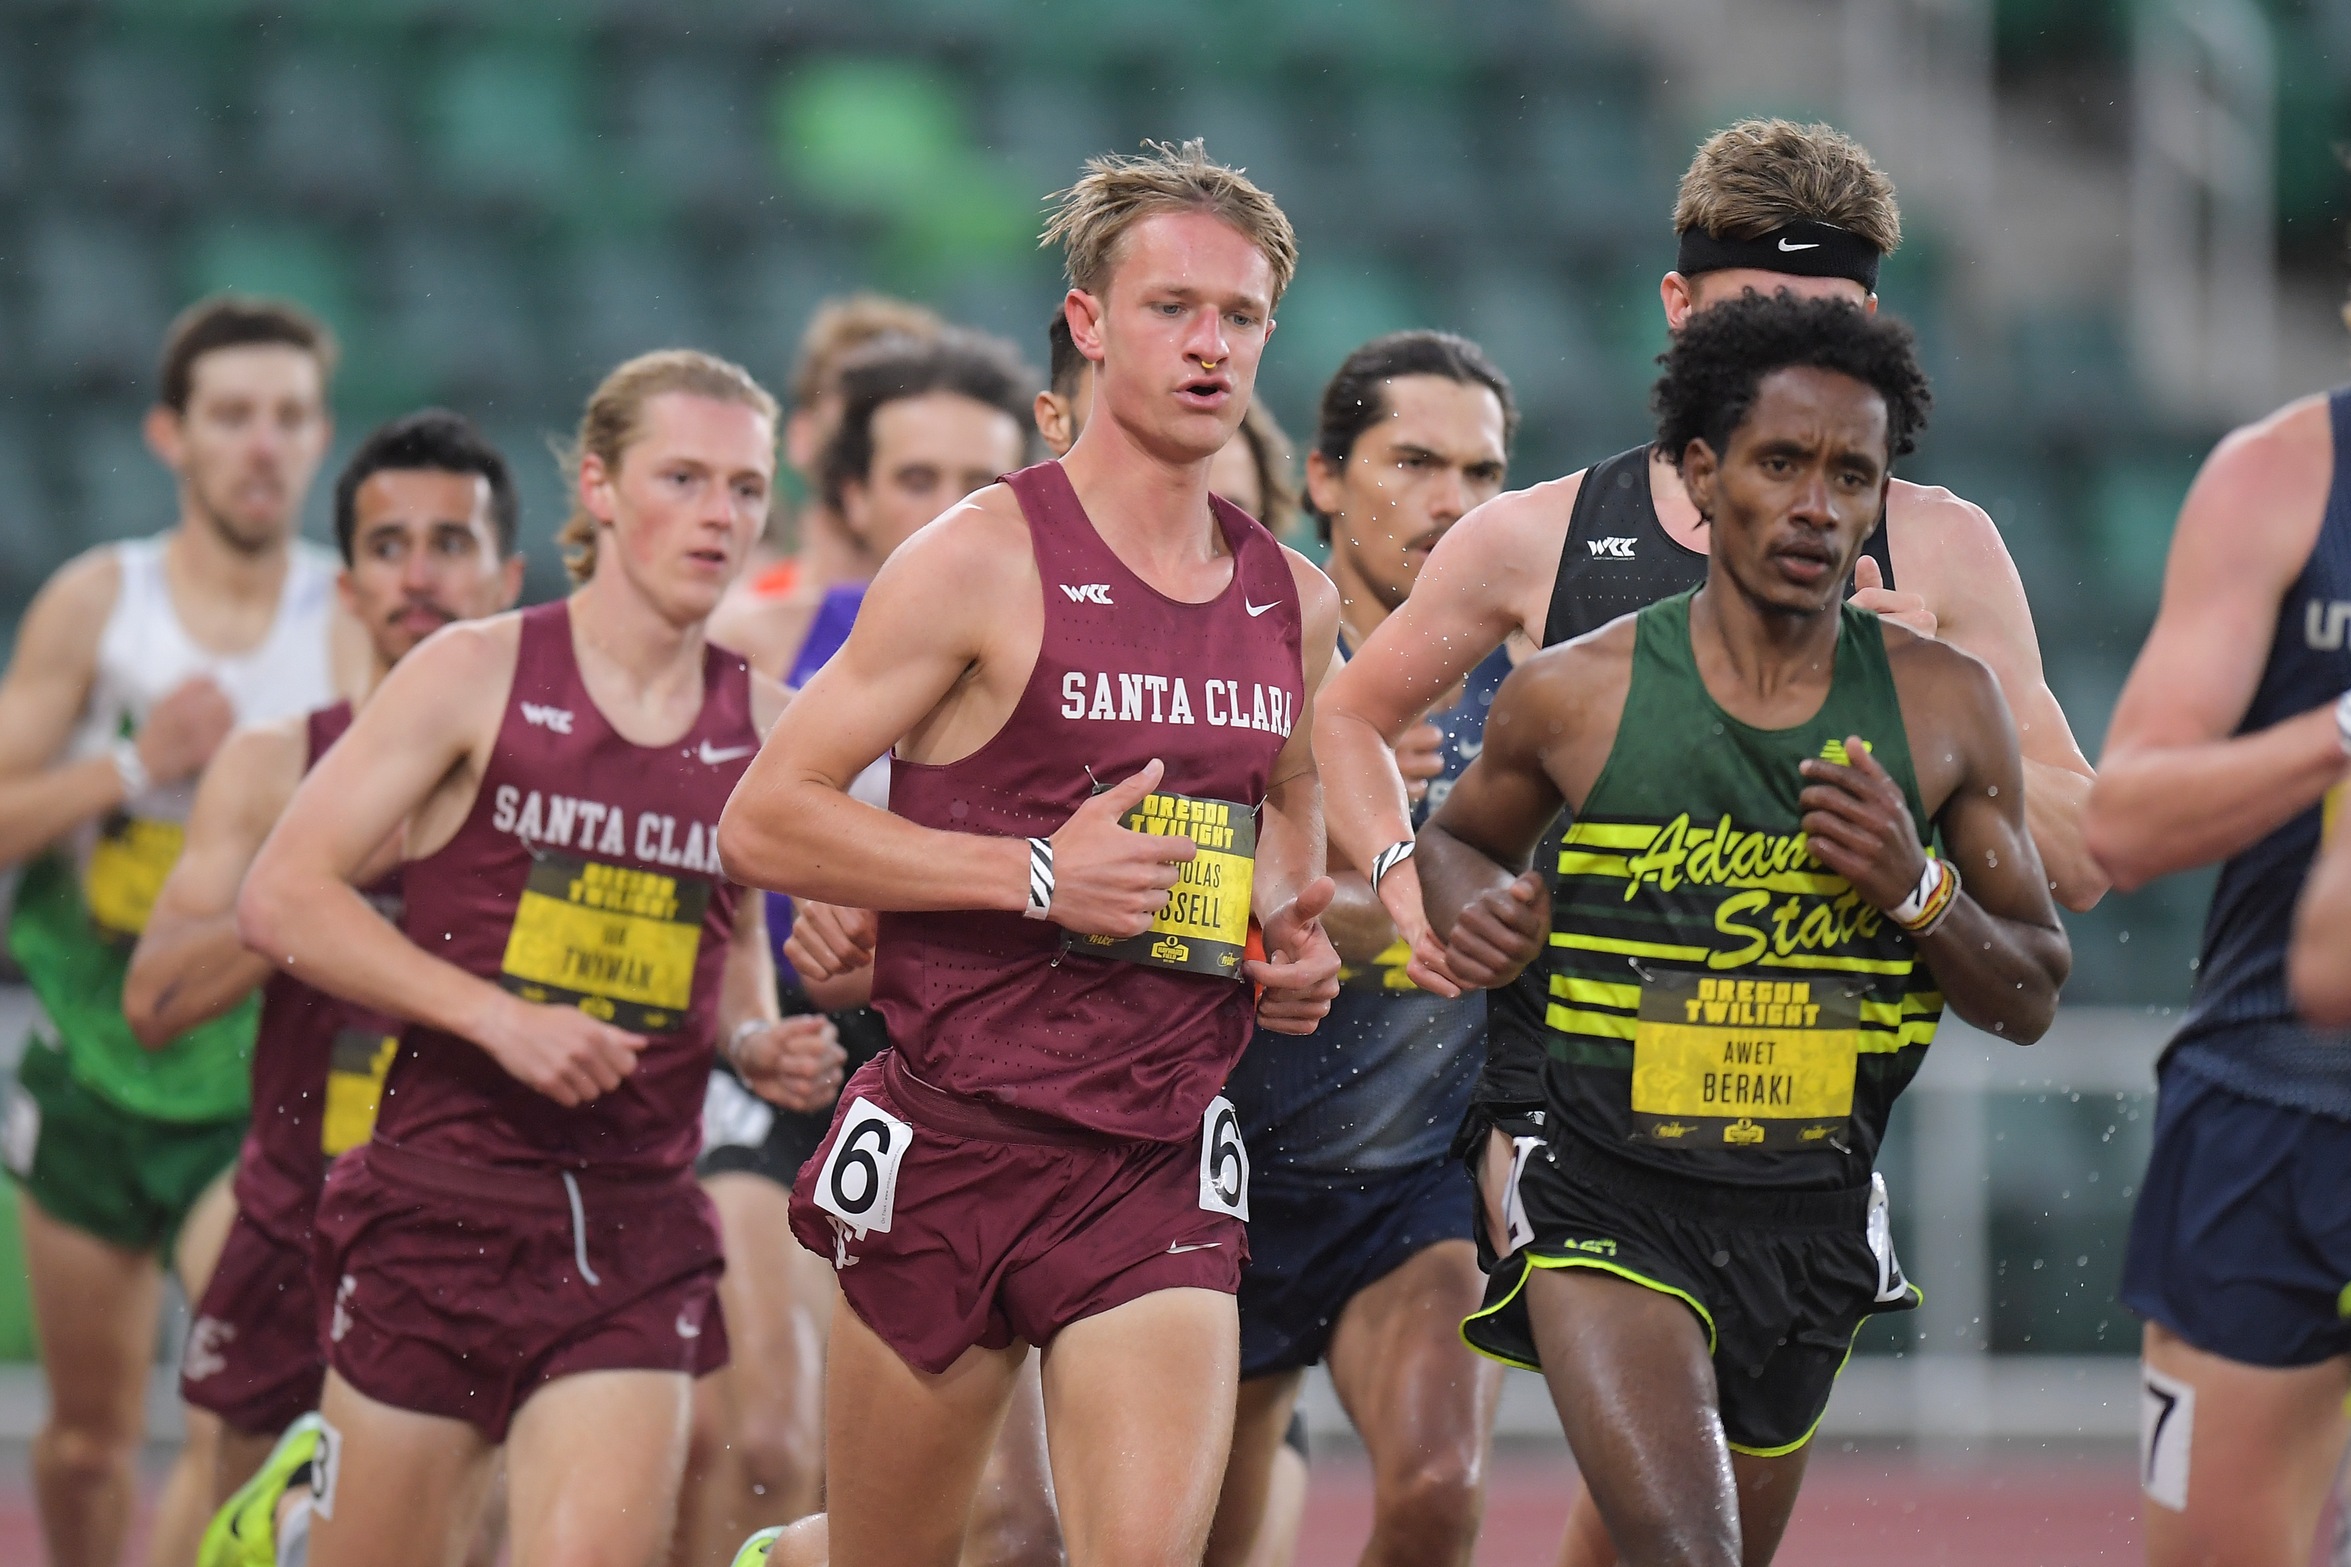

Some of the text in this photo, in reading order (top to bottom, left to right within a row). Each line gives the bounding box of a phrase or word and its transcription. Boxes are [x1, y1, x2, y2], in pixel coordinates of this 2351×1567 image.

[1587, 536, 1638, 557] WCC
[1059, 584, 1114, 605] WCC
[2305, 600, 2351, 651] U
[1061, 671, 1292, 739] SANTA CLARA
[492, 784, 626, 857] SANTA
[1130, 814, 1234, 850] TWILIGHT
[1142, 794, 1229, 827] OREGON
[1624, 812, 1822, 902] Adam
[1707, 888, 1883, 970] State
[1698, 978, 1810, 1004] OREGON
[1685, 999, 1820, 1027] TWILIGHT
[1723, 1041, 1777, 1065] AWET
[1703, 1073, 1792, 1106] BERAKI
[830, 1118, 890, 1214] 6
[1210, 1108, 1242, 1208] 6
[2146, 1380, 2177, 1483] 7
